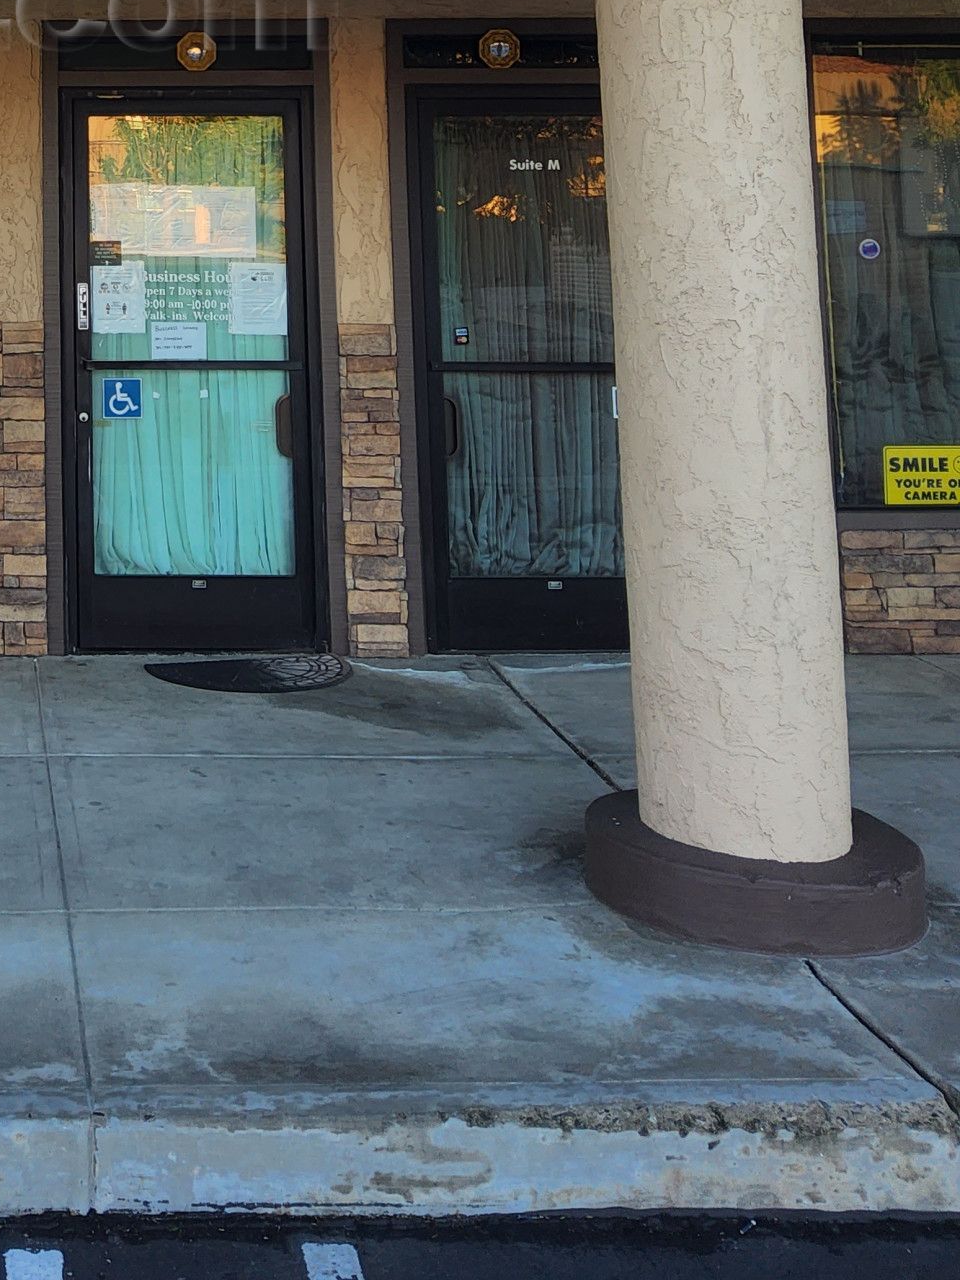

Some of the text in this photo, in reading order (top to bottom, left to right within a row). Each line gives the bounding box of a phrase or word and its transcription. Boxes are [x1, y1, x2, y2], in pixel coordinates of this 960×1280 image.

[509, 158, 561, 171] Suite M
[144, 287, 166, 298] pen
[169, 286, 175, 296] 7
[178, 286, 203, 298] Days
[168, 301, 184, 309] am
[888, 456, 949, 473] SMILE
[894, 478, 960, 489] YOU'RE O
[904, 491, 958, 501] CAMERA
